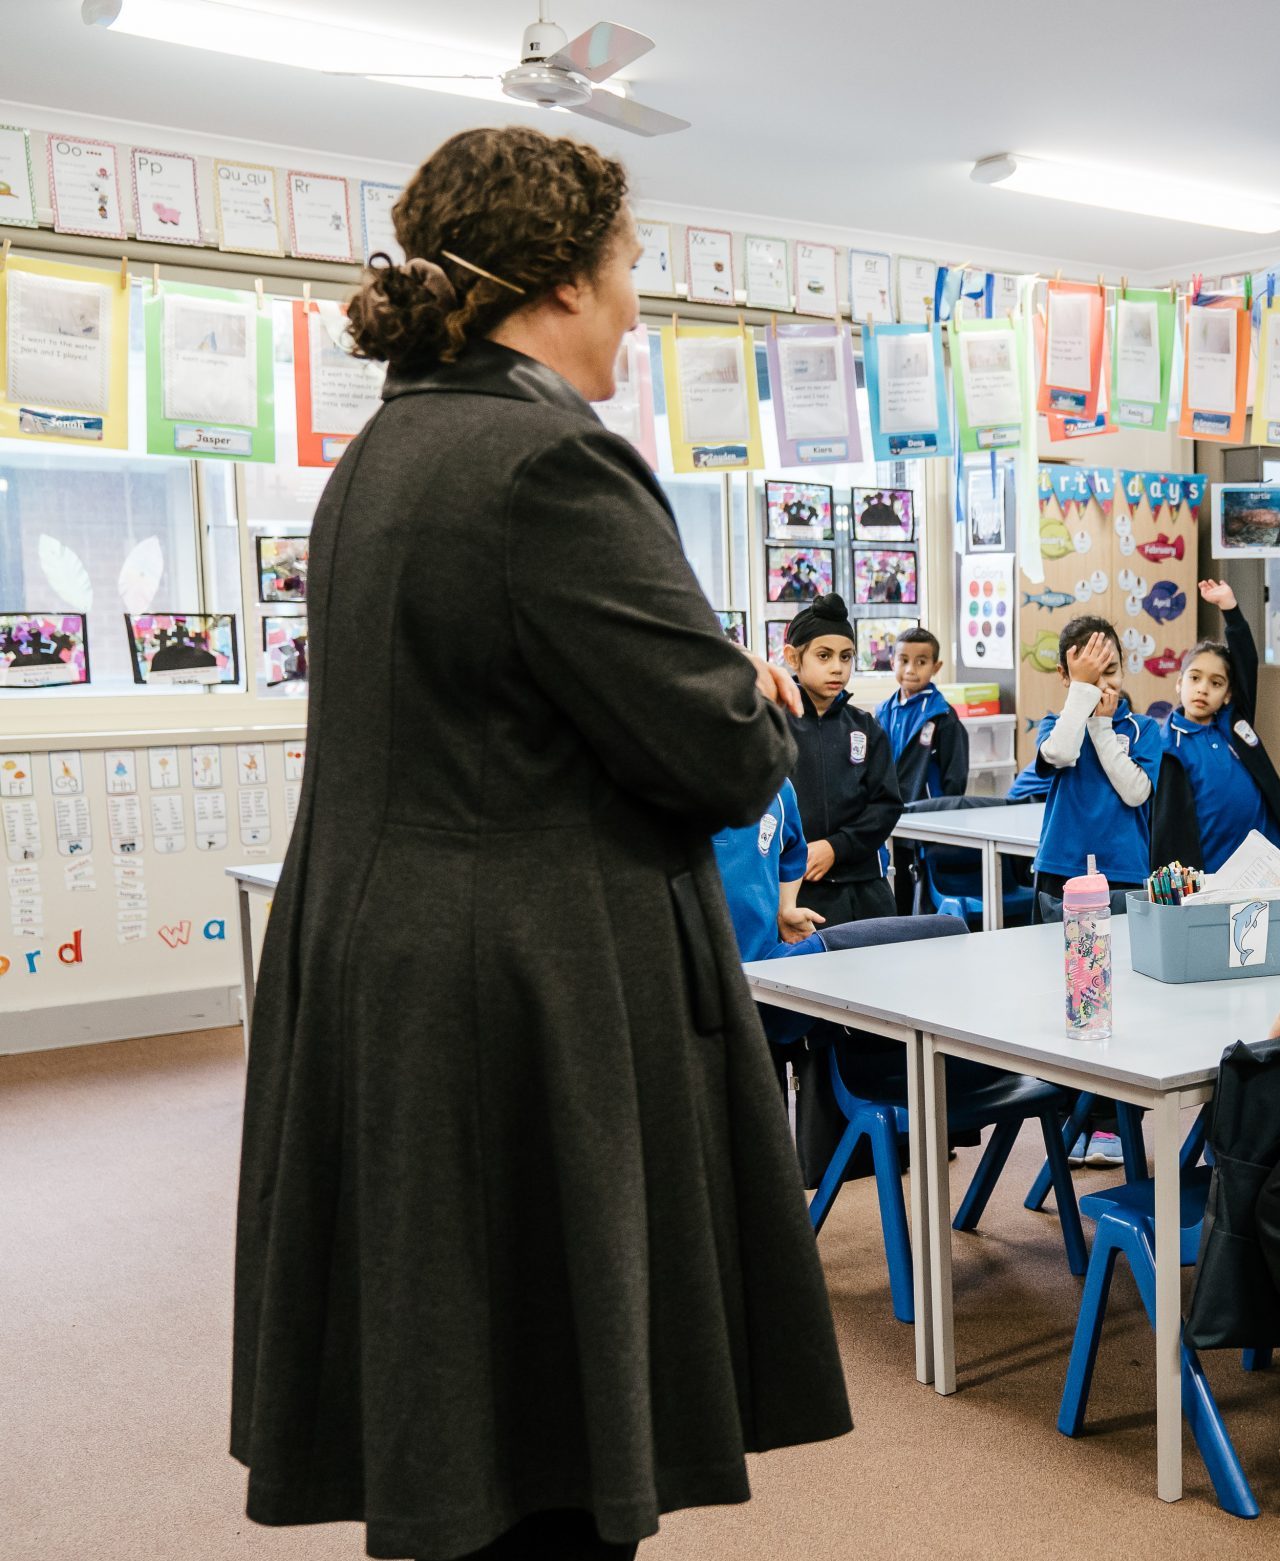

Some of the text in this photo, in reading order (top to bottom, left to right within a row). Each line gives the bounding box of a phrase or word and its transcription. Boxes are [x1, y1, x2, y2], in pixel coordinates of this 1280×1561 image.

[56, 142, 82, 157] Oo
[138, 156, 163, 176] Pp
[218, 166, 267, 189] Qu qu
[294, 178, 311, 194] Rr
[366, 189, 381, 202] Ss
[691, 233, 706, 246] Xx
[60, 340, 73, 348] the
[195, 433, 232, 446] Jasper
[1041, 472, 1199, 505] irthdays
[1250, 492, 1271, 501] turtle
[1144, 545, 1176, 557] February
